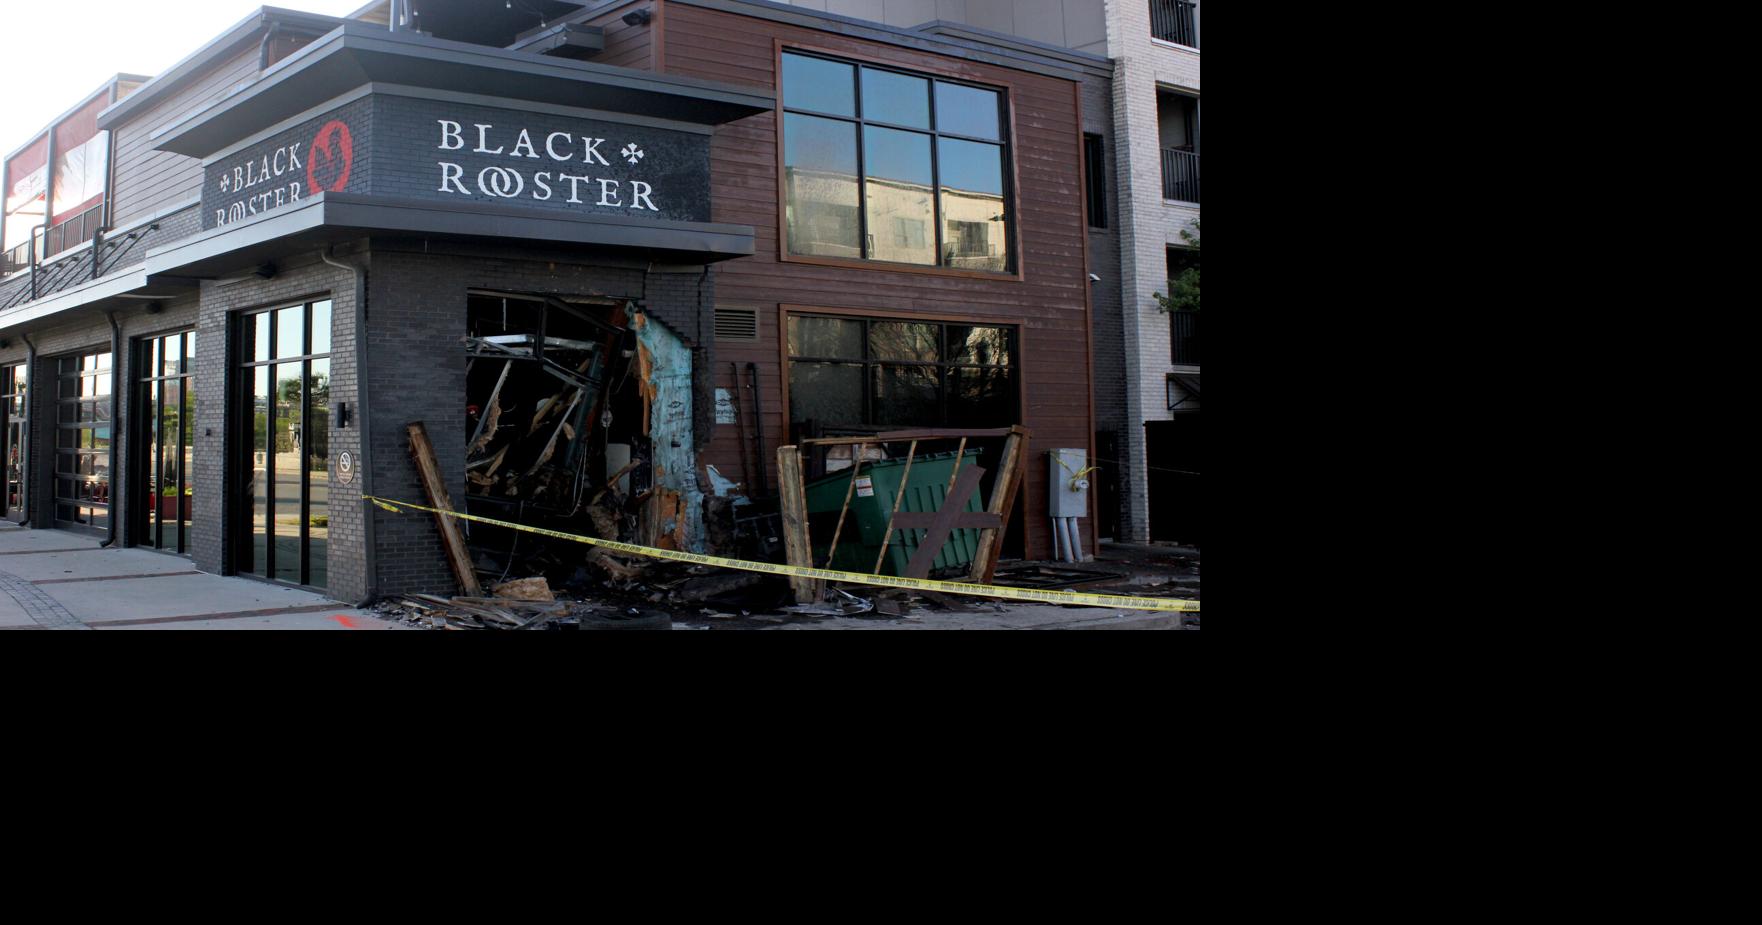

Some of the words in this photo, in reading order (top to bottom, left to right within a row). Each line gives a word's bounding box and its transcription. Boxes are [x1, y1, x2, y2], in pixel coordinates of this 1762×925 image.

[437, 119, 610, 166] BLACK
[233, 142, 302, 193] BLACK
[437, 161, 659, 211] ROOSTER
[216, 182, 301, 227] ROOSTER
